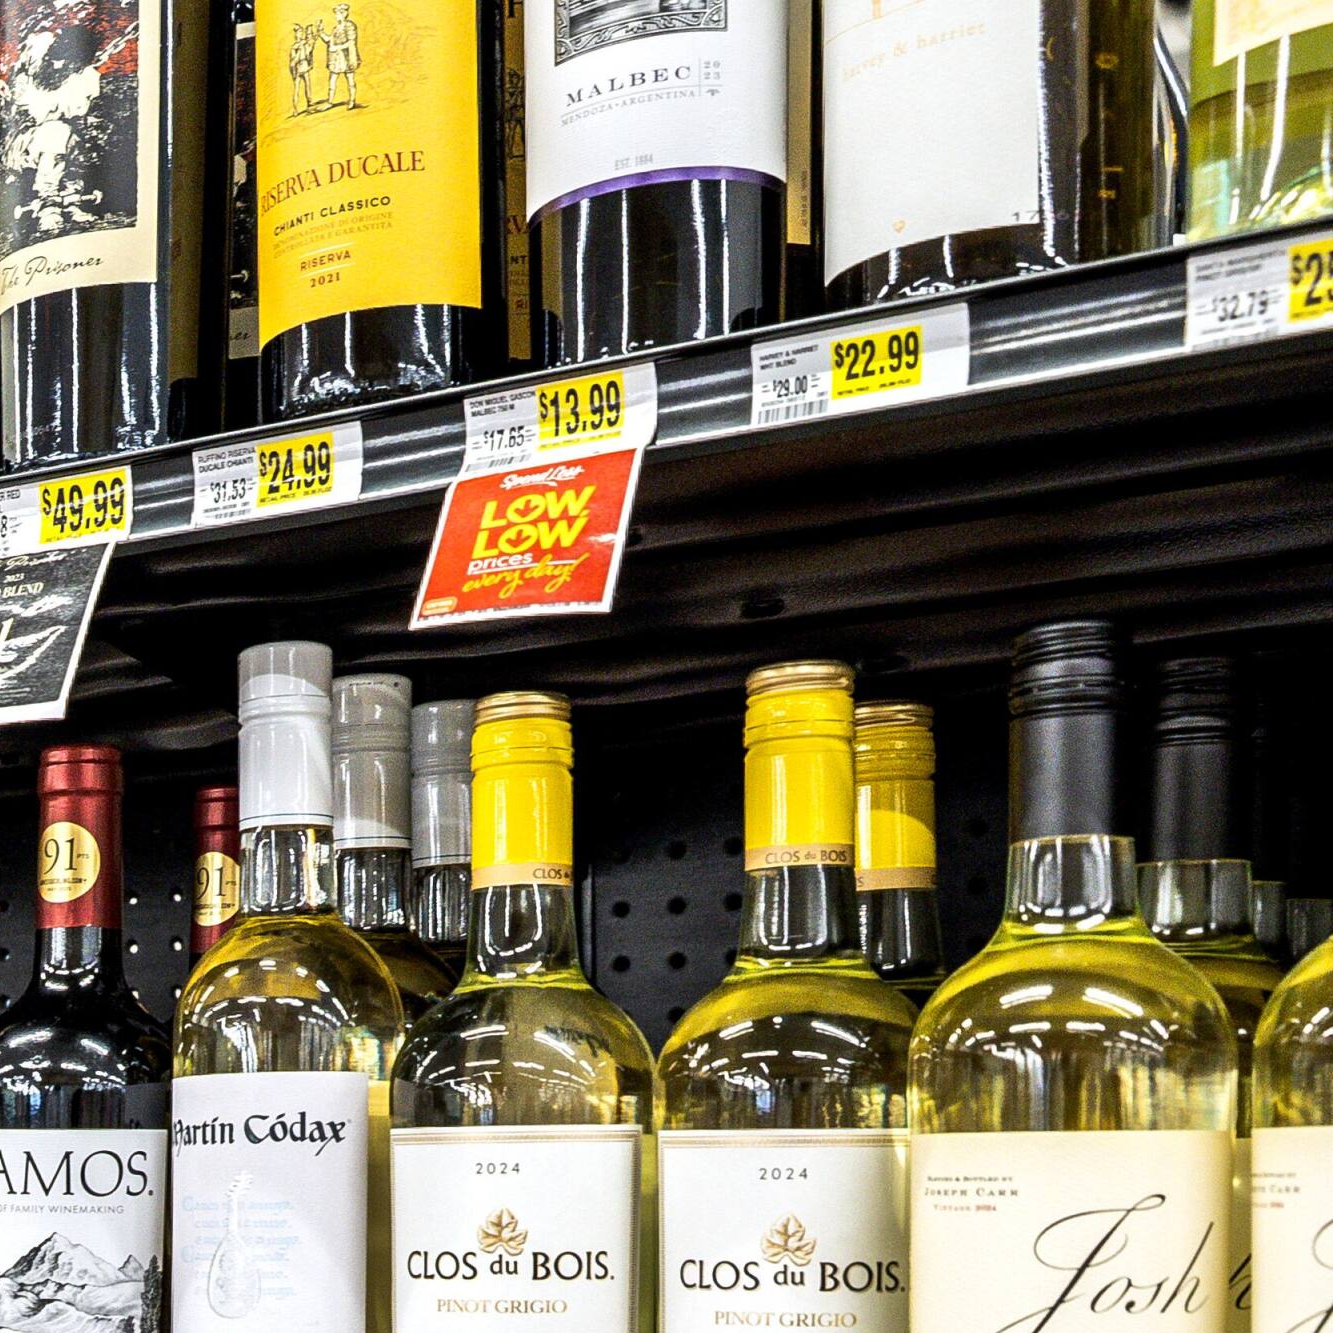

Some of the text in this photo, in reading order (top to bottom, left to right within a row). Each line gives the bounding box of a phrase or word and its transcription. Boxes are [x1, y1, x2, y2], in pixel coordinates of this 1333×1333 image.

[566, 65, 692, 108] MALBEC
[261, 150, 426, 217] RISERVA DUCALE
[273, 212, 315, 237] CHIANTI
[319, 195, 392, 219] CLASSICO
[300, 249, 352, 272] RISERVA
[309, 272, 342, 288] 2021
[834, 331, 920, 381] $22.99
[772, 375, 808, 398] $29.00
[539, 380, 622, 438] $13.99
[482, 426, 525, 451] $17.65
[199, 463, 225, 473] DUCALE
[259, 441, 331, 494] $24.99
[7, 489, 21, 500] RED
[42, 477, 125, 533] $49.99
[471, 518, 589, 560] LOW
[467, 553, 534, 578] prices
[2, 581, 44, 599] BLEND
[462, 570, 524, 598] every
[44, 838, 79, 874] 91
[244, 1111, 347, 1156] Códax
[475, 1162, 522, 1175] 2024
[759, 1167, 809, 1181] 2024
[407, 1250, 616, 1282] CLOS du BOIS.
[680, 1259, 907, 1293] CLOS du BOIS.
[437, 1299, 568, 1315] PINOT GRIGIO
[714, 1311, 858, 1328] PINOT GRIGIO
